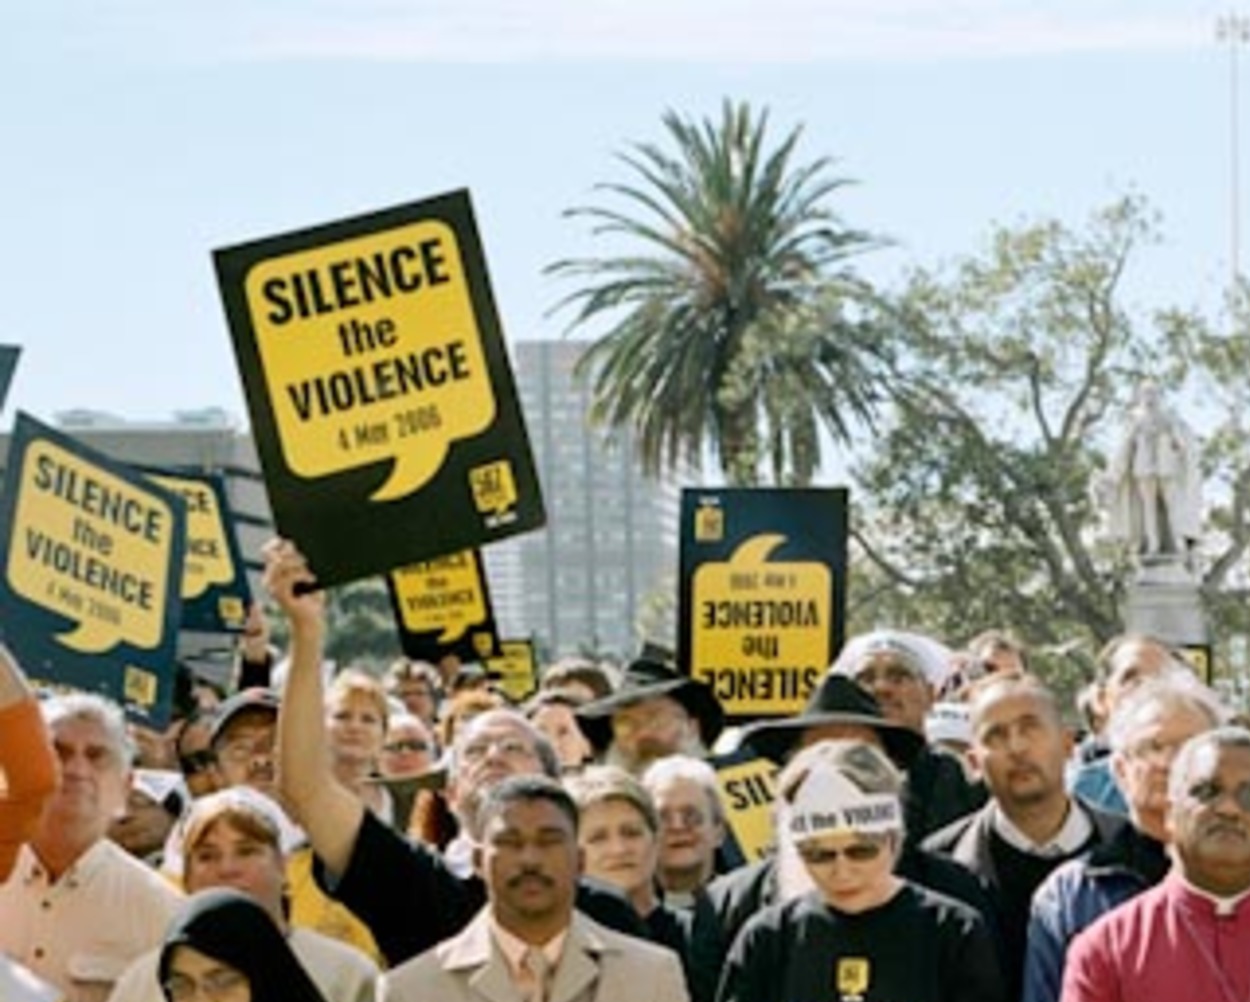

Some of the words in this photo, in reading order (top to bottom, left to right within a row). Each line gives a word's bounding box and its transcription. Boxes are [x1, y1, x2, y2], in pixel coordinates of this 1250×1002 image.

[262, 238, 450, 326] SILENCE
[337, 317, 398, 357] the
[286, 340, 471, 422] VIOLENCE
[337, 427, 350, 451] 4
[34, 455, 163, 545] SILENCE
[72, 517, 114, 556] the
[25, 526, 155, 611] VIOLENCE
[702, 600, 819, 630] VIOLENCE
[742, 634, 778, 659] the
